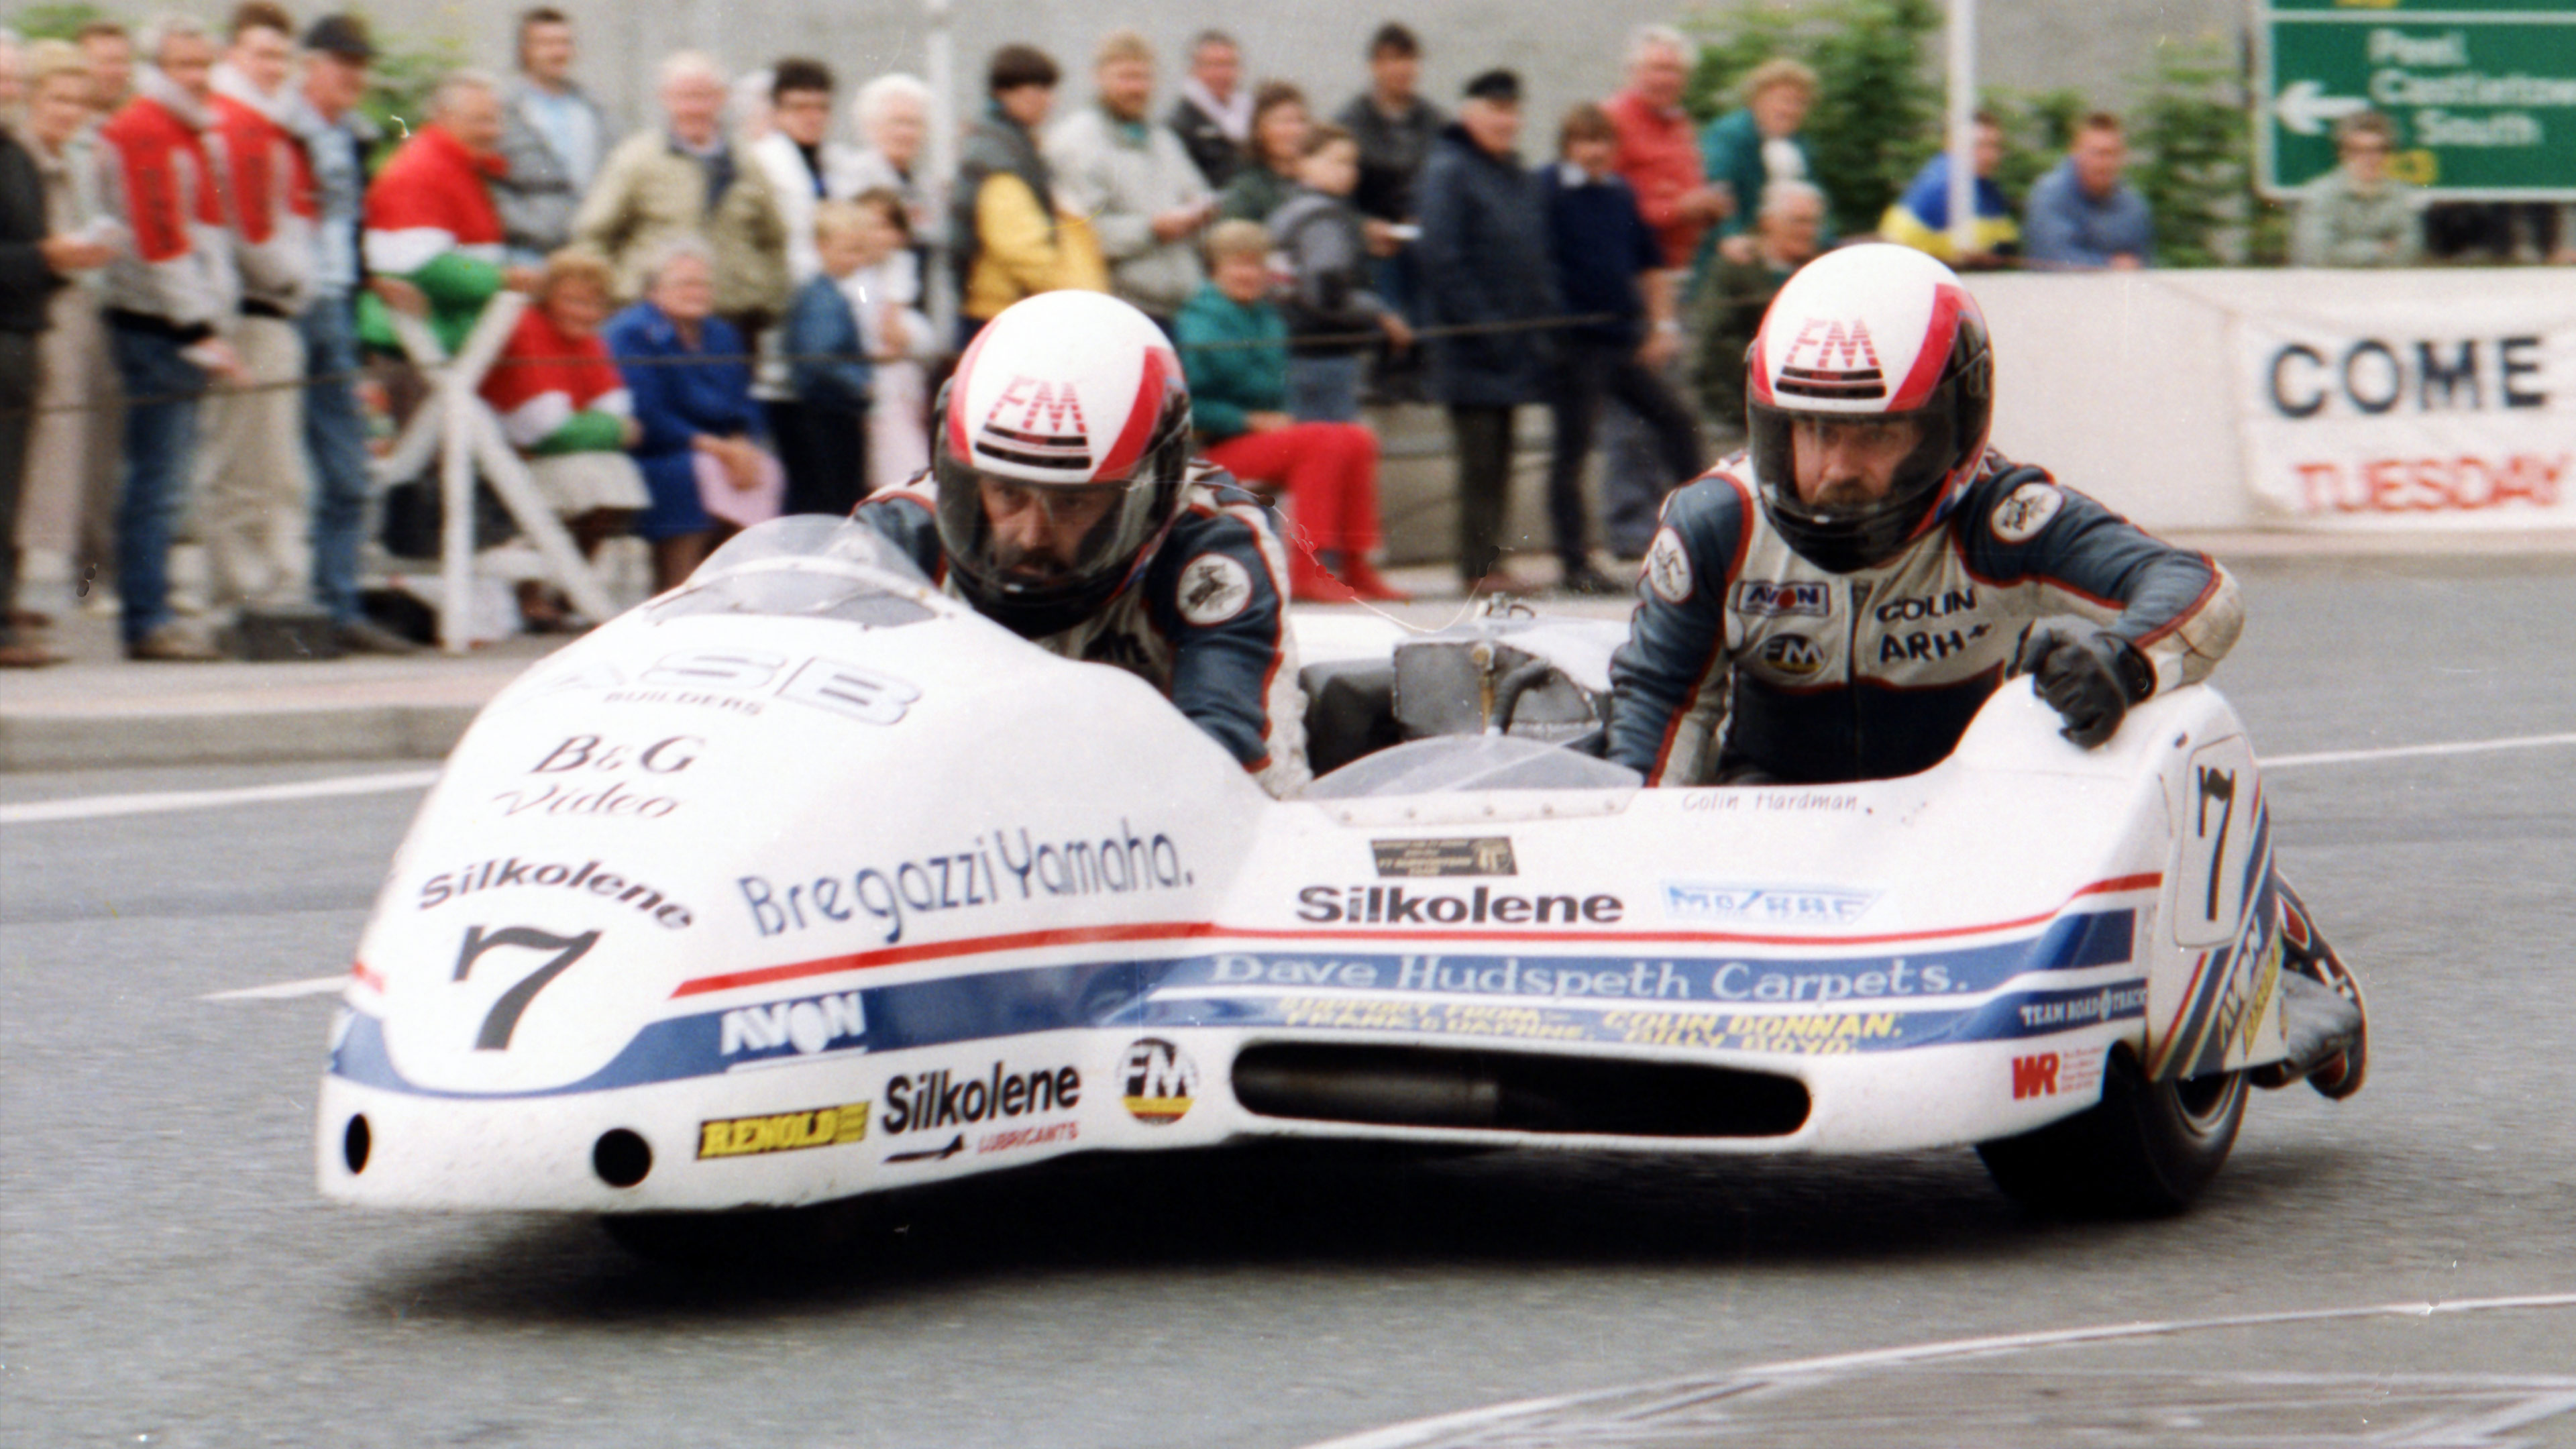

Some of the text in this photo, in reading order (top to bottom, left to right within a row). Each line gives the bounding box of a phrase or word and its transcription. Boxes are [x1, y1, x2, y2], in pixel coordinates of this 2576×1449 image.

[2268, 337, 2547, 417] COME
[2294, 453, 2573, 512] TUESDAY
[1748, 586, 1819, 608] AVON
[1876, 586, 1978, 623] COLIN
[603, 690, 765, 716] BUILDERS
[492, 781, 680, 818] Video
[1681, 792, 1739, 811] Colin
[2196, 765, 2236, 922] 7
[419, 857, 694, 929] Silkolene
[738, 818, 1195, 943] Bregazzi Yamaha.
[1296, 885, 1625, 924] Silkolene
[452, 925, 604, 1051] 7
[1210, 954, 1968, 1007] Dave Hudspeth Carpets.
[720, 991, 867, 1055] AVON
[1602, 1011, 1719, 1030] COLIN
[2019, 1002, 2065, 1027] TEAM
[883, 1061, 1081, 1135] Silkolene
[2012, 1052, 2060, 1100] WR
[702, 1108, 839, 1157] RENOLD
[977, 1121, 1079, 1154] LUBRICANTS
